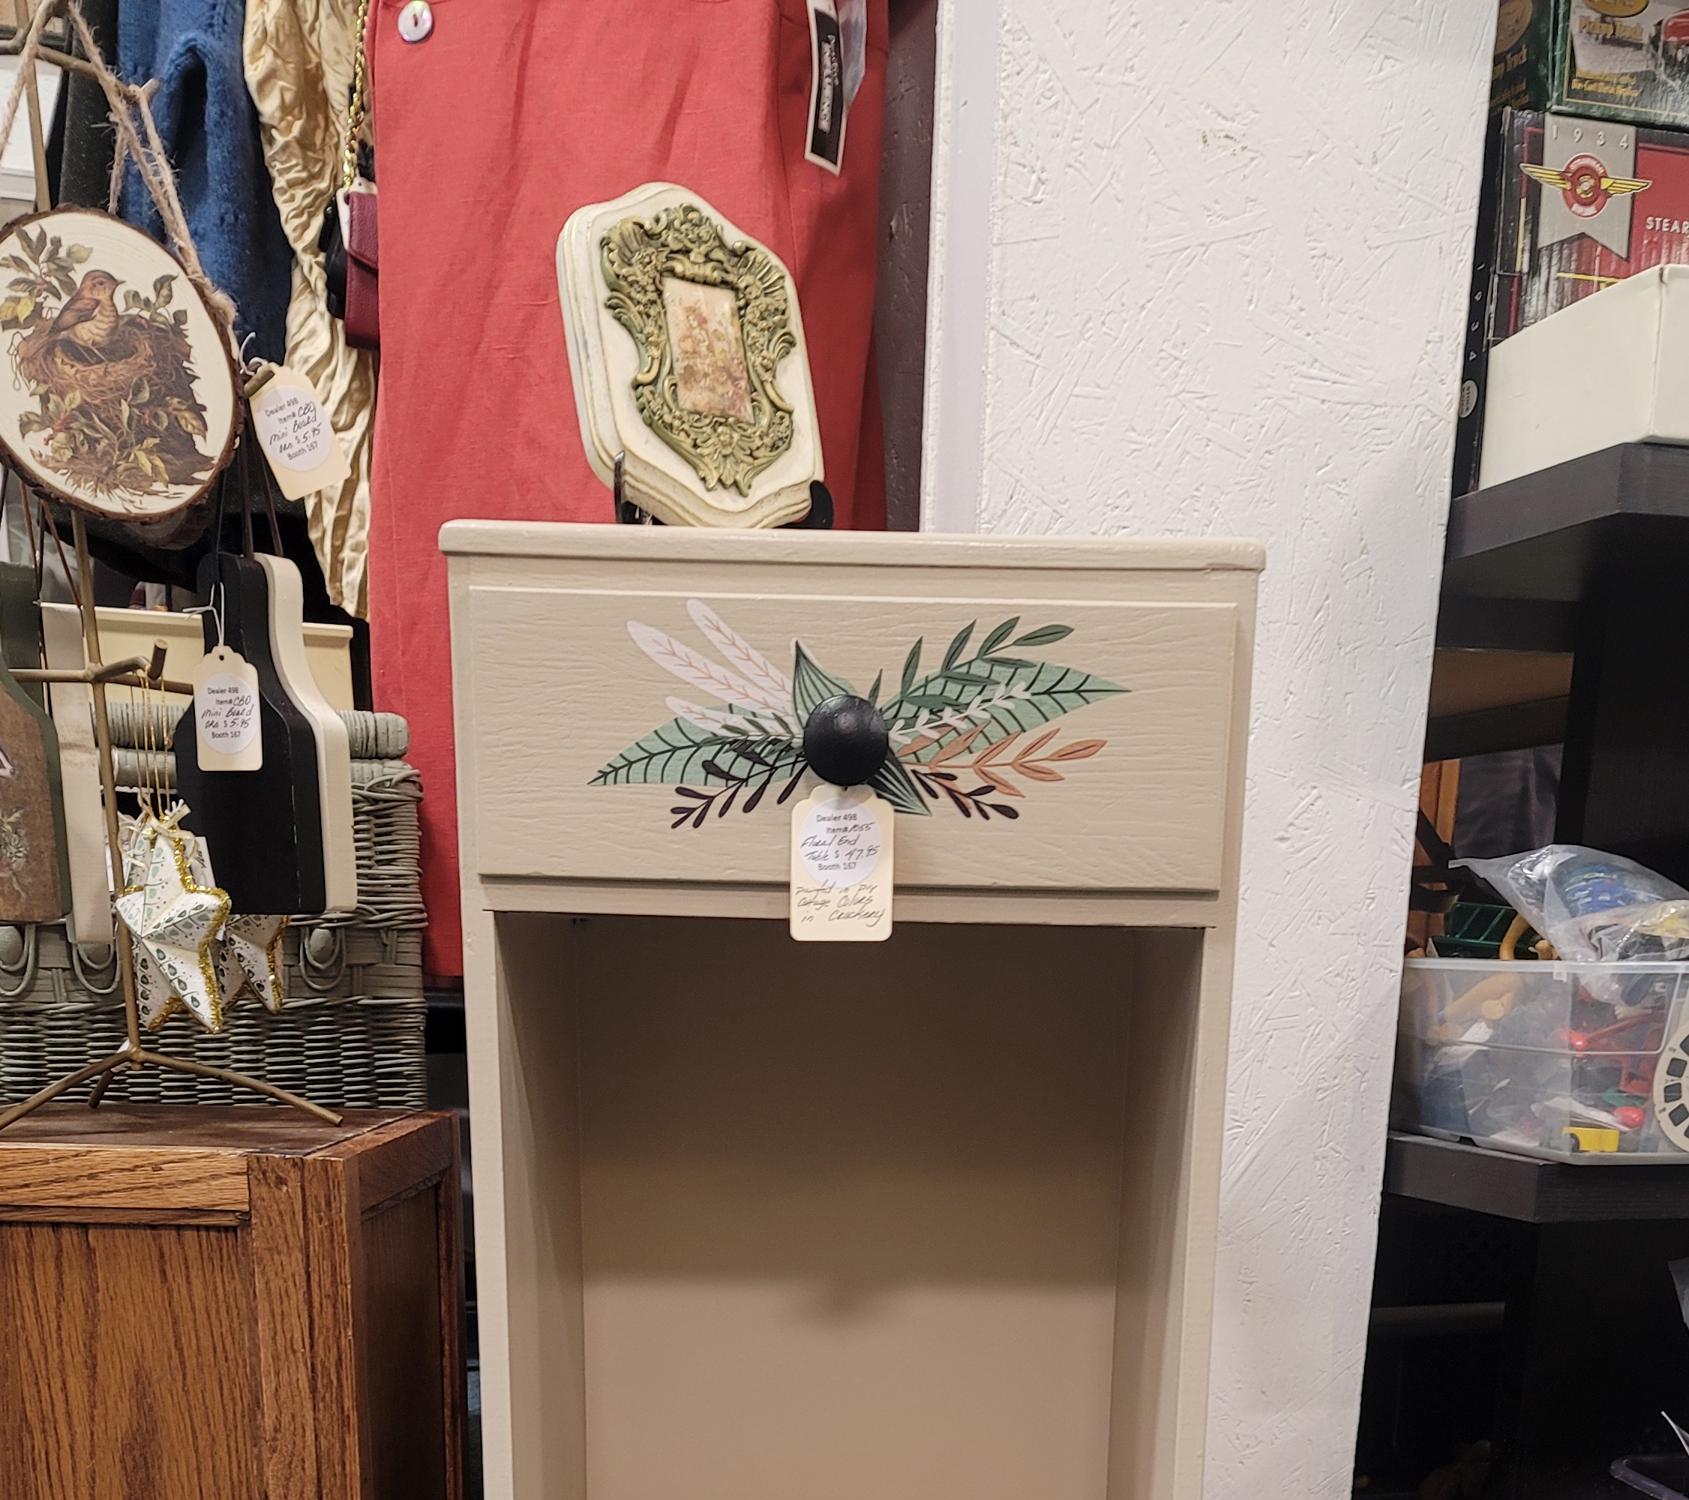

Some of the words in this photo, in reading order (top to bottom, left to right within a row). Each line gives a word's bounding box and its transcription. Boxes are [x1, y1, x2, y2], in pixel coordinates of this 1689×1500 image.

[1551, 124, 1631, 150] 1934
[265, 403, 286, 417] Dealer
[288, 447, 307, 460] Booth
[207, 687, 227, 695] Dealer
[211, 731, 229, 739] Booth
[816, 814, 842, 822] Dealer
[837, 833, 861, 846] End
[845, 845, 880, 861] 47.95
[818, 863, 841, 871] Booth
